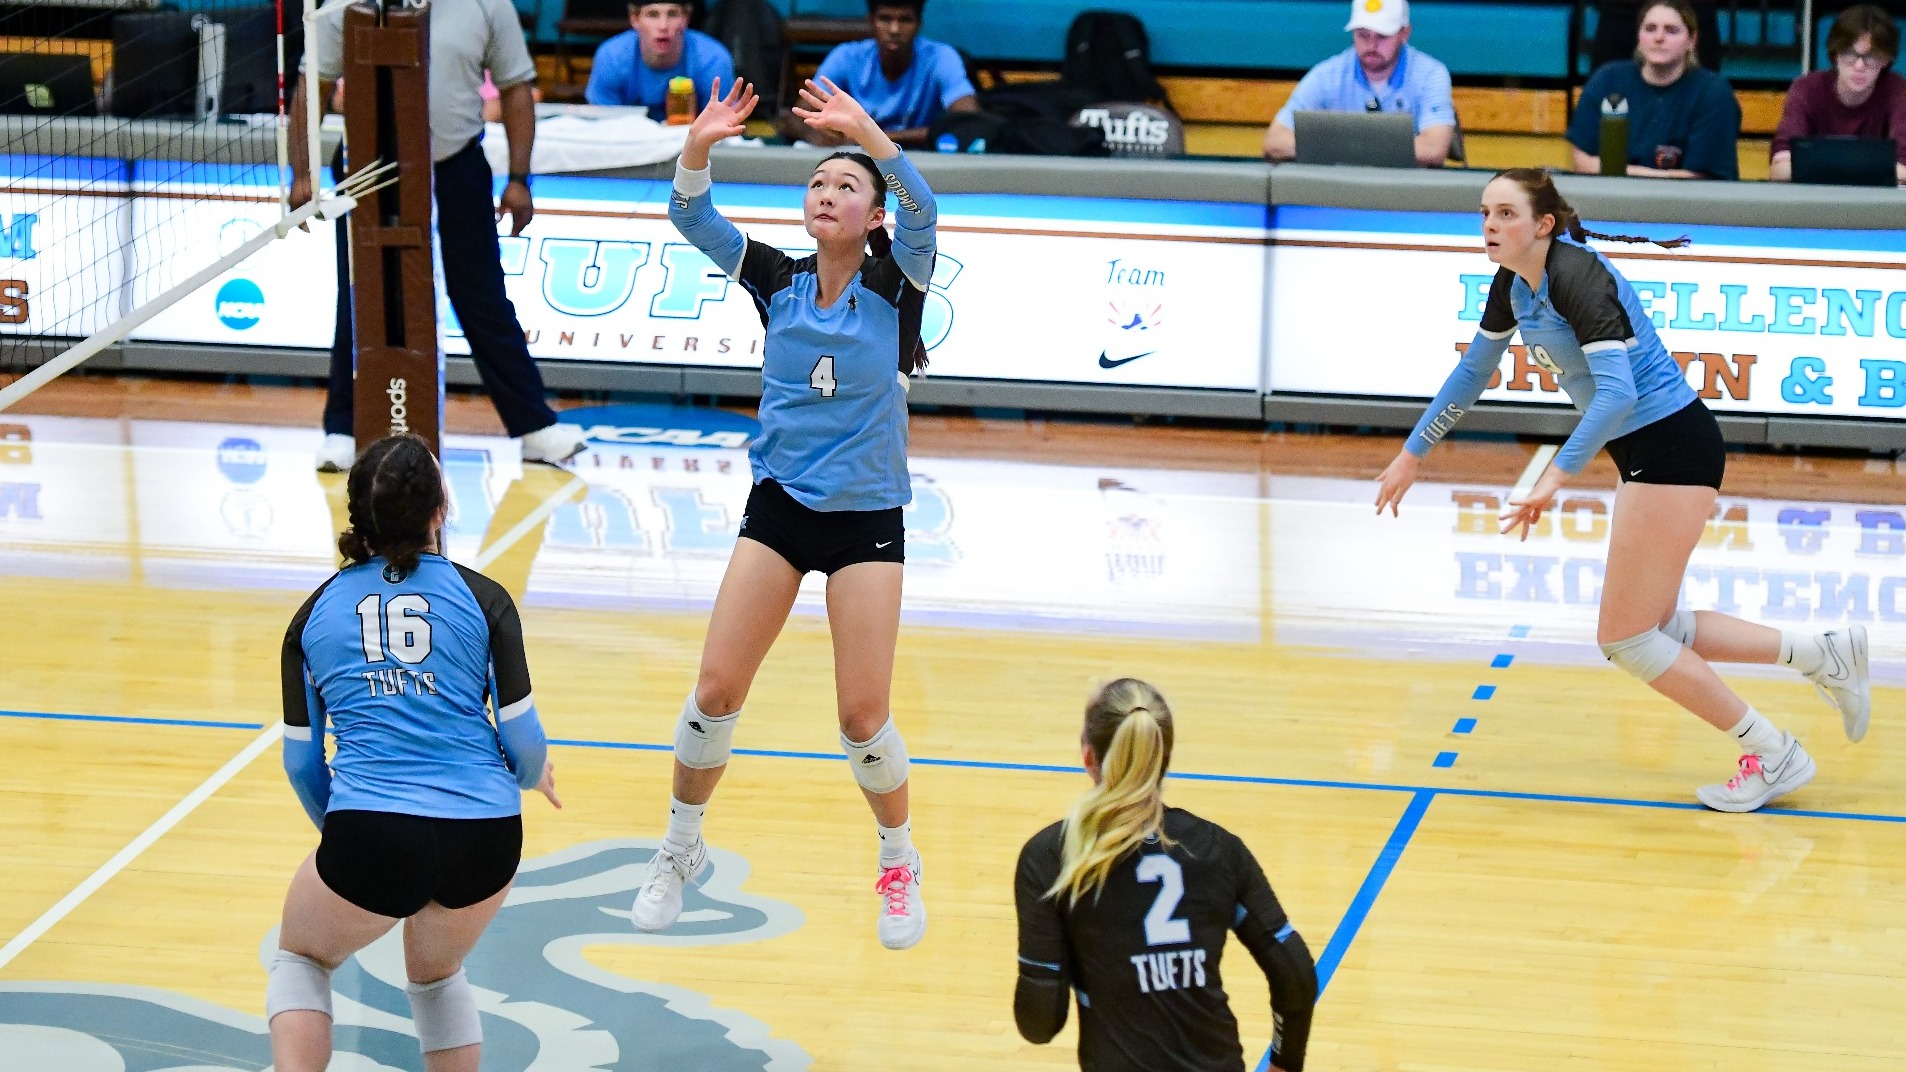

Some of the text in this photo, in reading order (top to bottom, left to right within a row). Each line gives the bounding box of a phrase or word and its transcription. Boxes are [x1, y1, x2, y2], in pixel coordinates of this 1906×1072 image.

[1080, 108, 1169, 145] Tufts
[1107, 258, 1165, 287] Team
[525, 328, 758, 355] UNIVERSI
[809, 355, 837, 397] 4
[1418, 402, 1465, 447] TUFTS
[356, 593, 432, 664] 16
[362, 668, 438, 697] TUFTS
[1135, 852, 1192, 946] 2
[1131, 948, 1206, 994] TUFTS
